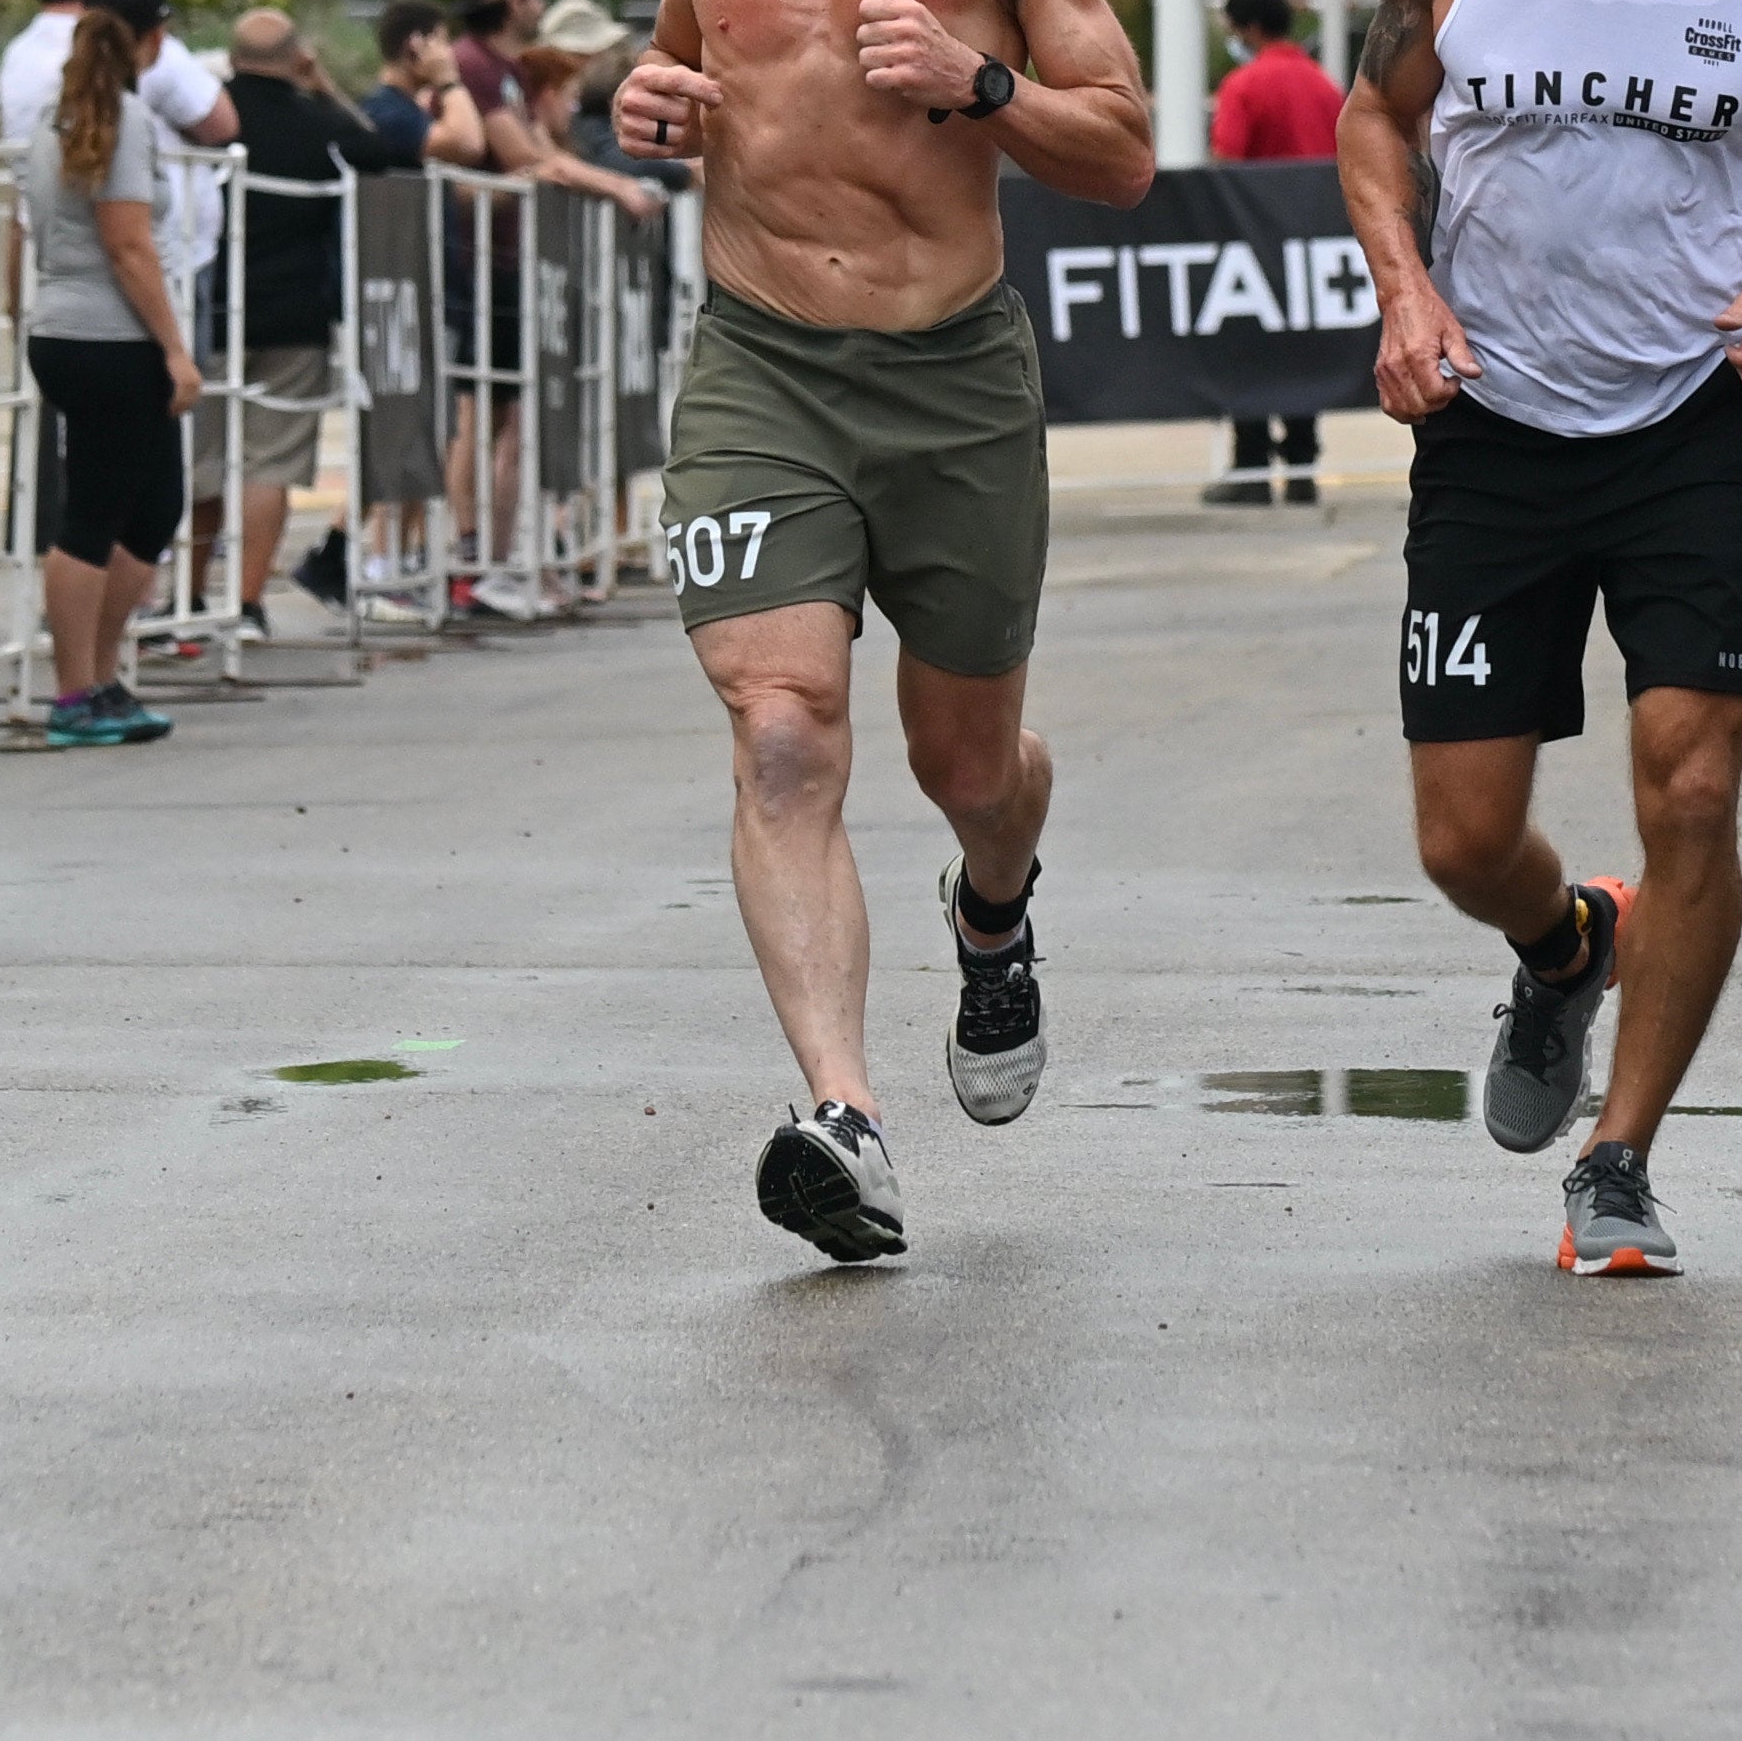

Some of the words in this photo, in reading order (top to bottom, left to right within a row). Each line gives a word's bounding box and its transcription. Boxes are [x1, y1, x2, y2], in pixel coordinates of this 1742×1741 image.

[1685, 26, 1742, 52] CrossFit
[1690, 46, 1734, 62] GAMES
[1467, 70, 1740, 128] TINCHER
[1544, 112, 1609, 125] FAIRFAX
[1615, 114, 1670, 136] UNITED
[1046, 235, 1382, 343] FITAID
[666, 510, 772, 597] 507
[1407, 609, 1492, 687] 514
